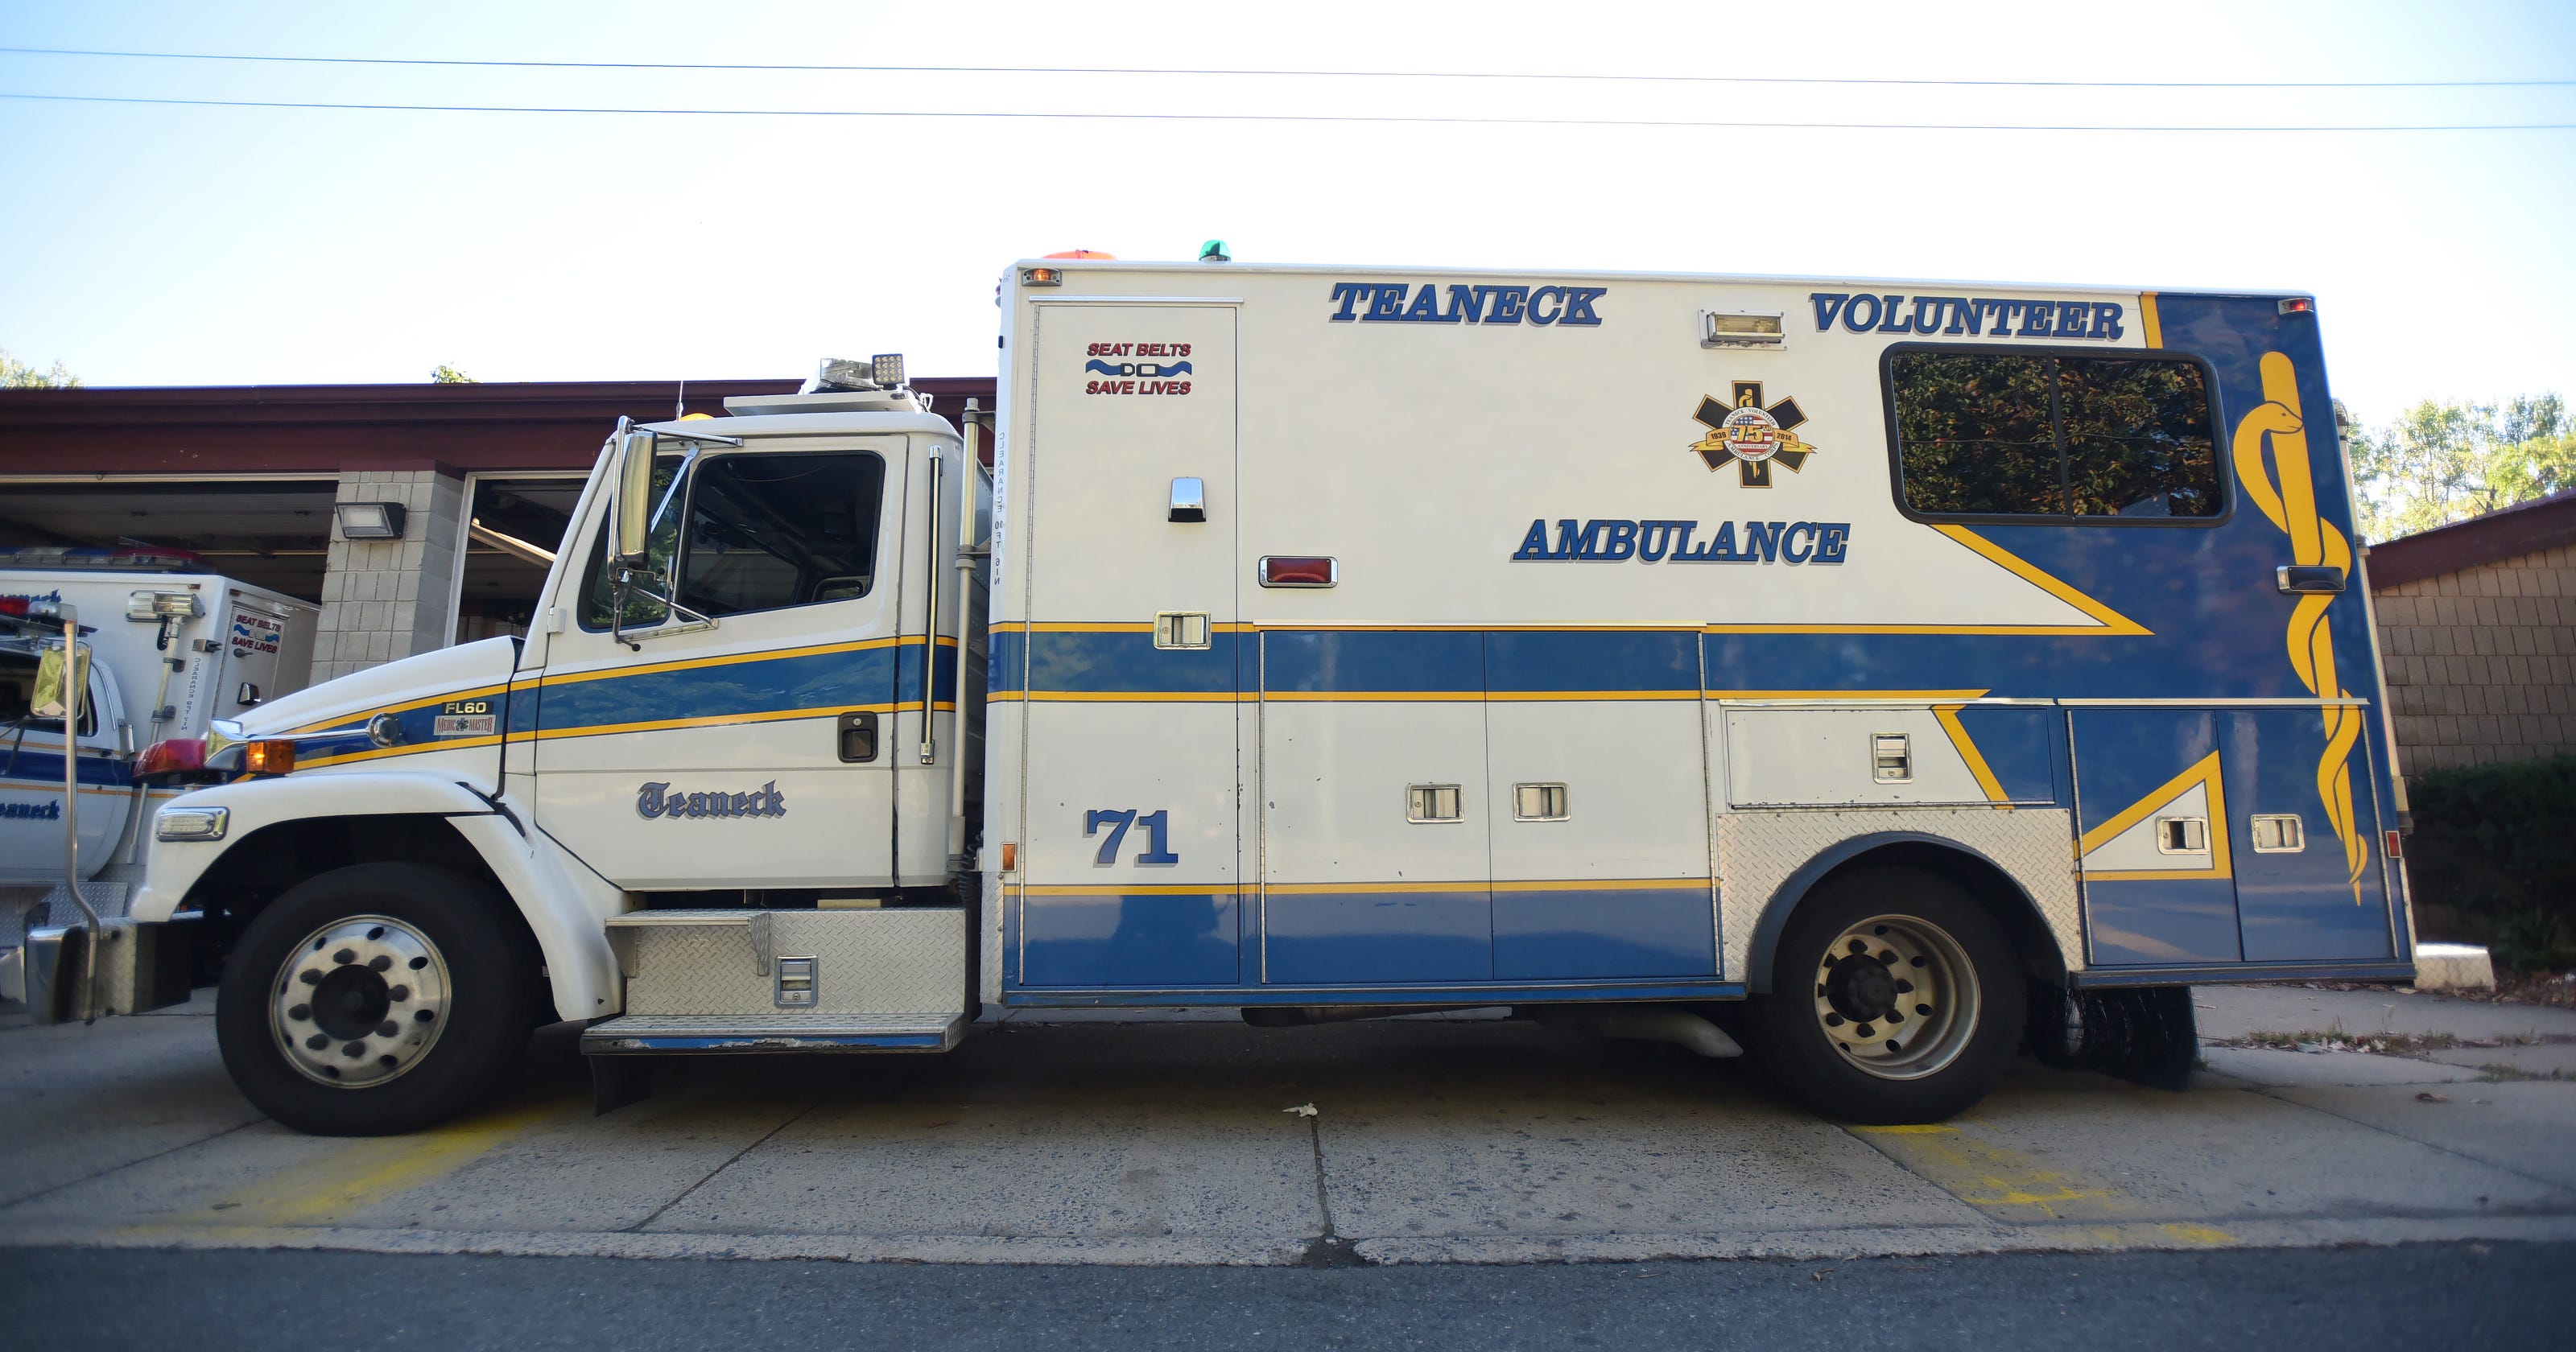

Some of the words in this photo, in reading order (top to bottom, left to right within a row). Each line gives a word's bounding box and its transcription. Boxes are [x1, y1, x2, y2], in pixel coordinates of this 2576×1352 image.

[1329, 282, 1608, 327] TEANECK
[1809, 293, 2124, 341] VOLUNTEER
[1087, 343, 1133, 357] SEAT
[1136, 343, 1191, 357] BELTS
[1086, 381, 1135, 394] SAVE
[1138, 381, 1191, 394] LIVES
[1711, 431, 1727, 440] 1939
[1777, 431, 1793, 441] 2014
[1509, 519, 1851, 567] AMBULANCE
[236, 615, 257, 626] SEAT
[257, 620, 281, 632] BELTS
[232, 637, 254, 648] SAVE
[254, 641, 278, 653] LIVES
[445, 702, 487, 714] FL60
[436, 717, 456, 733] MEDIC
[469, 716, 493, 733] MASTER
[635, 779, 787, 821] Teaneck
[1083, 809, 1179, 868] 71
